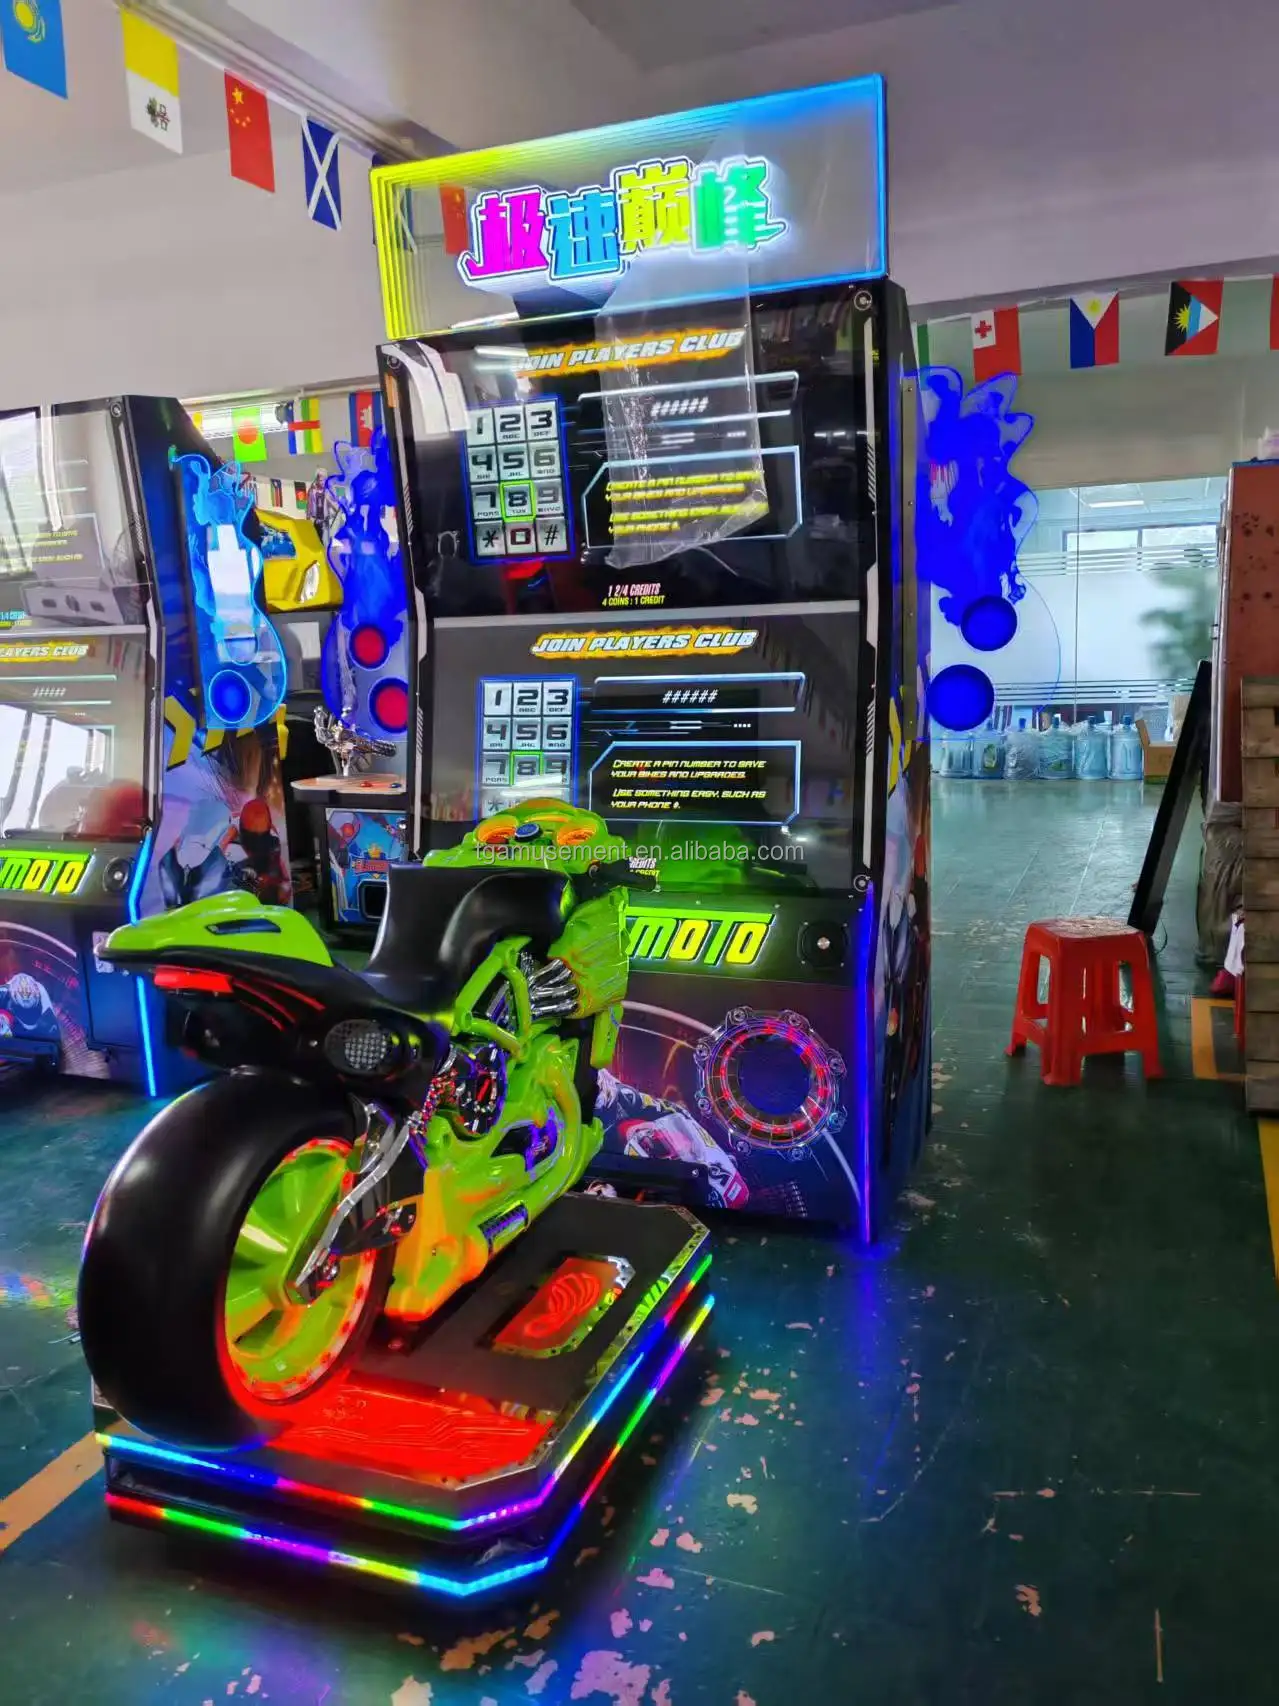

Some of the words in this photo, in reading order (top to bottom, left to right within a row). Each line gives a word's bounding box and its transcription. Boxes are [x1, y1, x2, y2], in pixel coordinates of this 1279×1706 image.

[460, 157, 786, 280] 极速巅峰
[568, 338, 675, 366] PLAYERS
[679, 330, 746, 353] CLUB
[477, 417, 483, 435] 1
[500, 414, 521, 432] 2
[531, 410, 553, 429] 3
[471, 453, 492, 471] 4
[503, 451, 524, 469] 5
[534, 449, 556, 467] 6
[475, 490, 496, 508] 7
[508, 490, 527, 507] 8
[538, 486, 559, 504] 9
[608, 597, 629, 606] COINS
[640, 595, 666, 605] CREDIT
[630, 583, 661, 596] CREDITS
[532, 638, 585, 653] JOIN
[589, 633, 690, 651] PLAYERS
[694, 630, 759, 648] CLUB
[495, 690, 502, 705] 1
[517, 689, 538, 705] 2
[546, 689, 569, 705] 3
[486, 724, 507, 740] 4
[516, 724, 537, 740] 5
[546, 724, 568, 740] 6
[485, 759, 506, 775] 7
[517, 759, 536, 775] 8
[625, 906, 776, 967] MOTO
